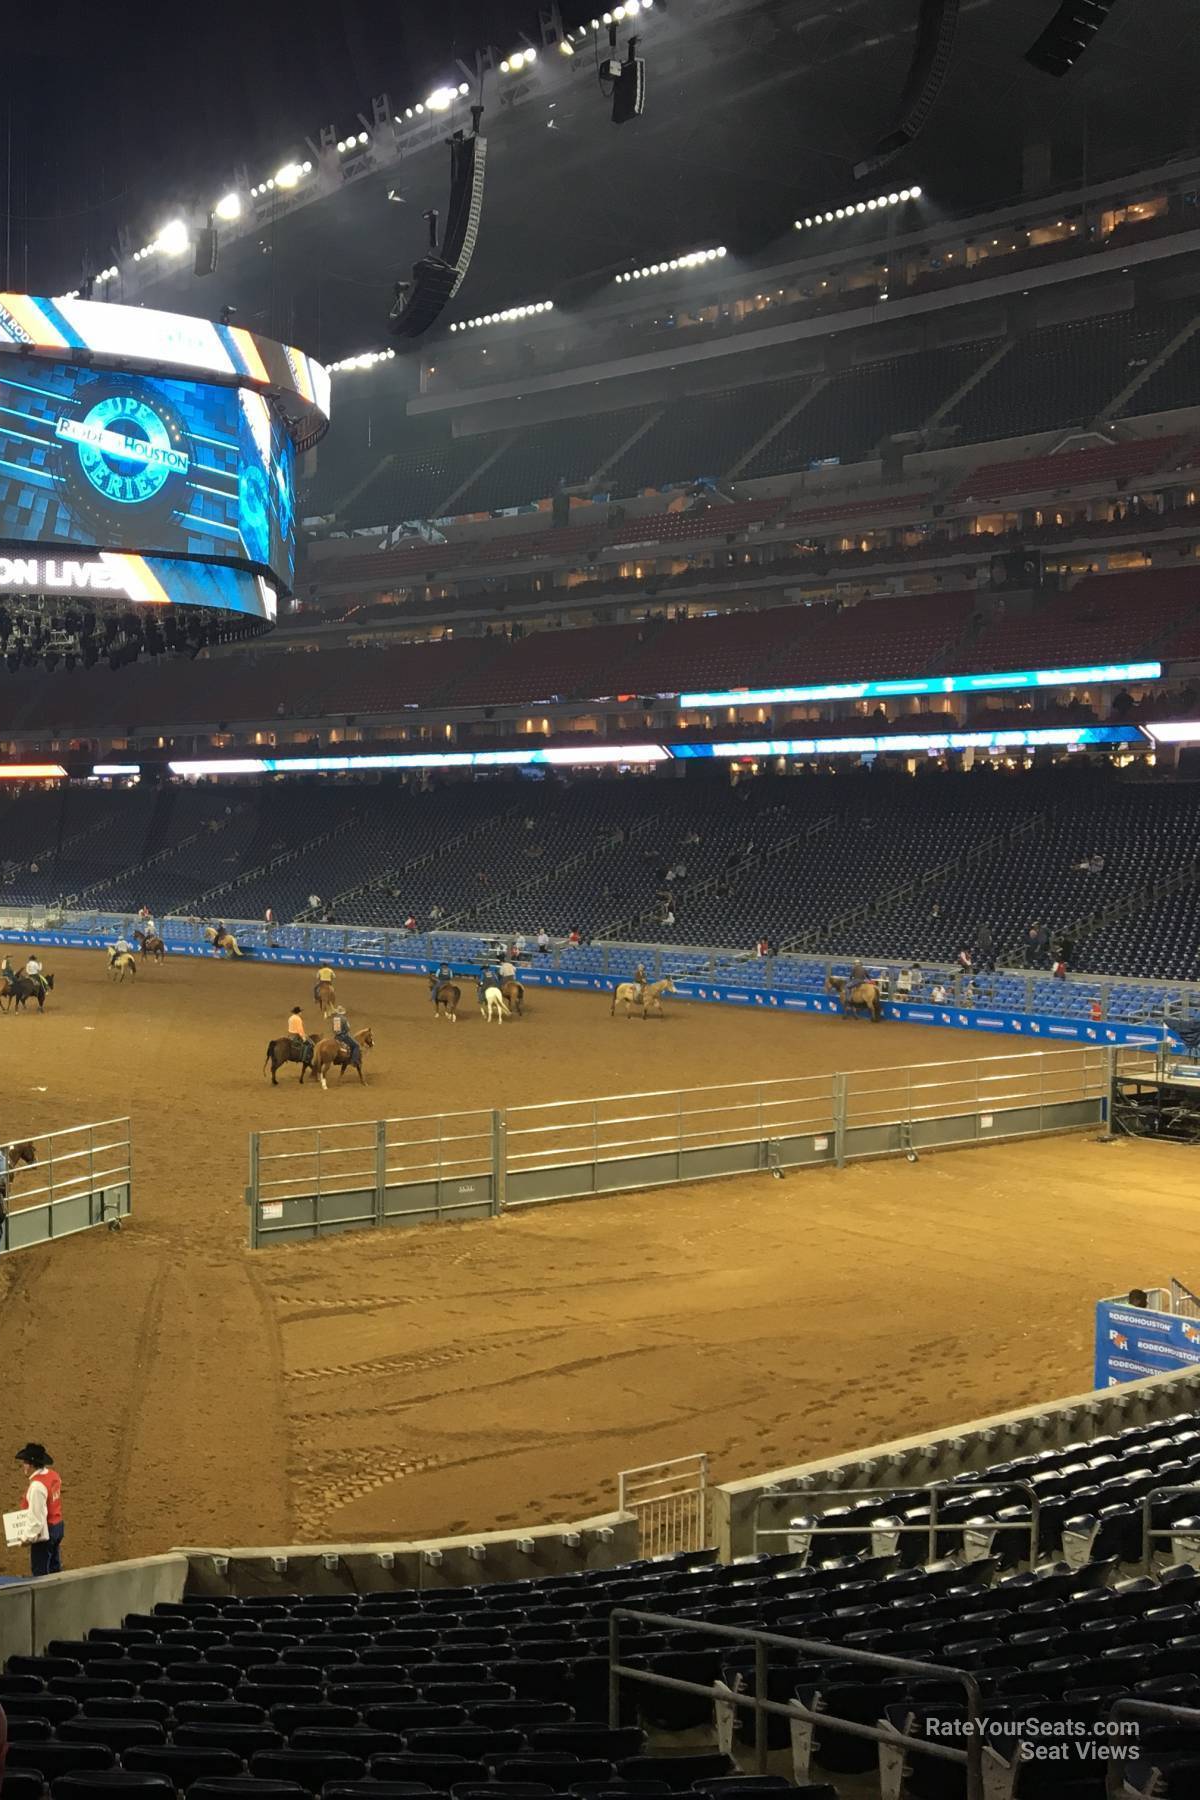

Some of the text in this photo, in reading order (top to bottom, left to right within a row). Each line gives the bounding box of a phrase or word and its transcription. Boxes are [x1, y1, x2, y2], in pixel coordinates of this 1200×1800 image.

[83, 452, 163, 499] SERIES
[1109, 1312, 1171, 1331] RODEOHOUSTON
[1137, 1341, 1200, 1362] RODEOHOUSTON
[1108, 1359, 1165, 1376] RODEOHOUSTO
